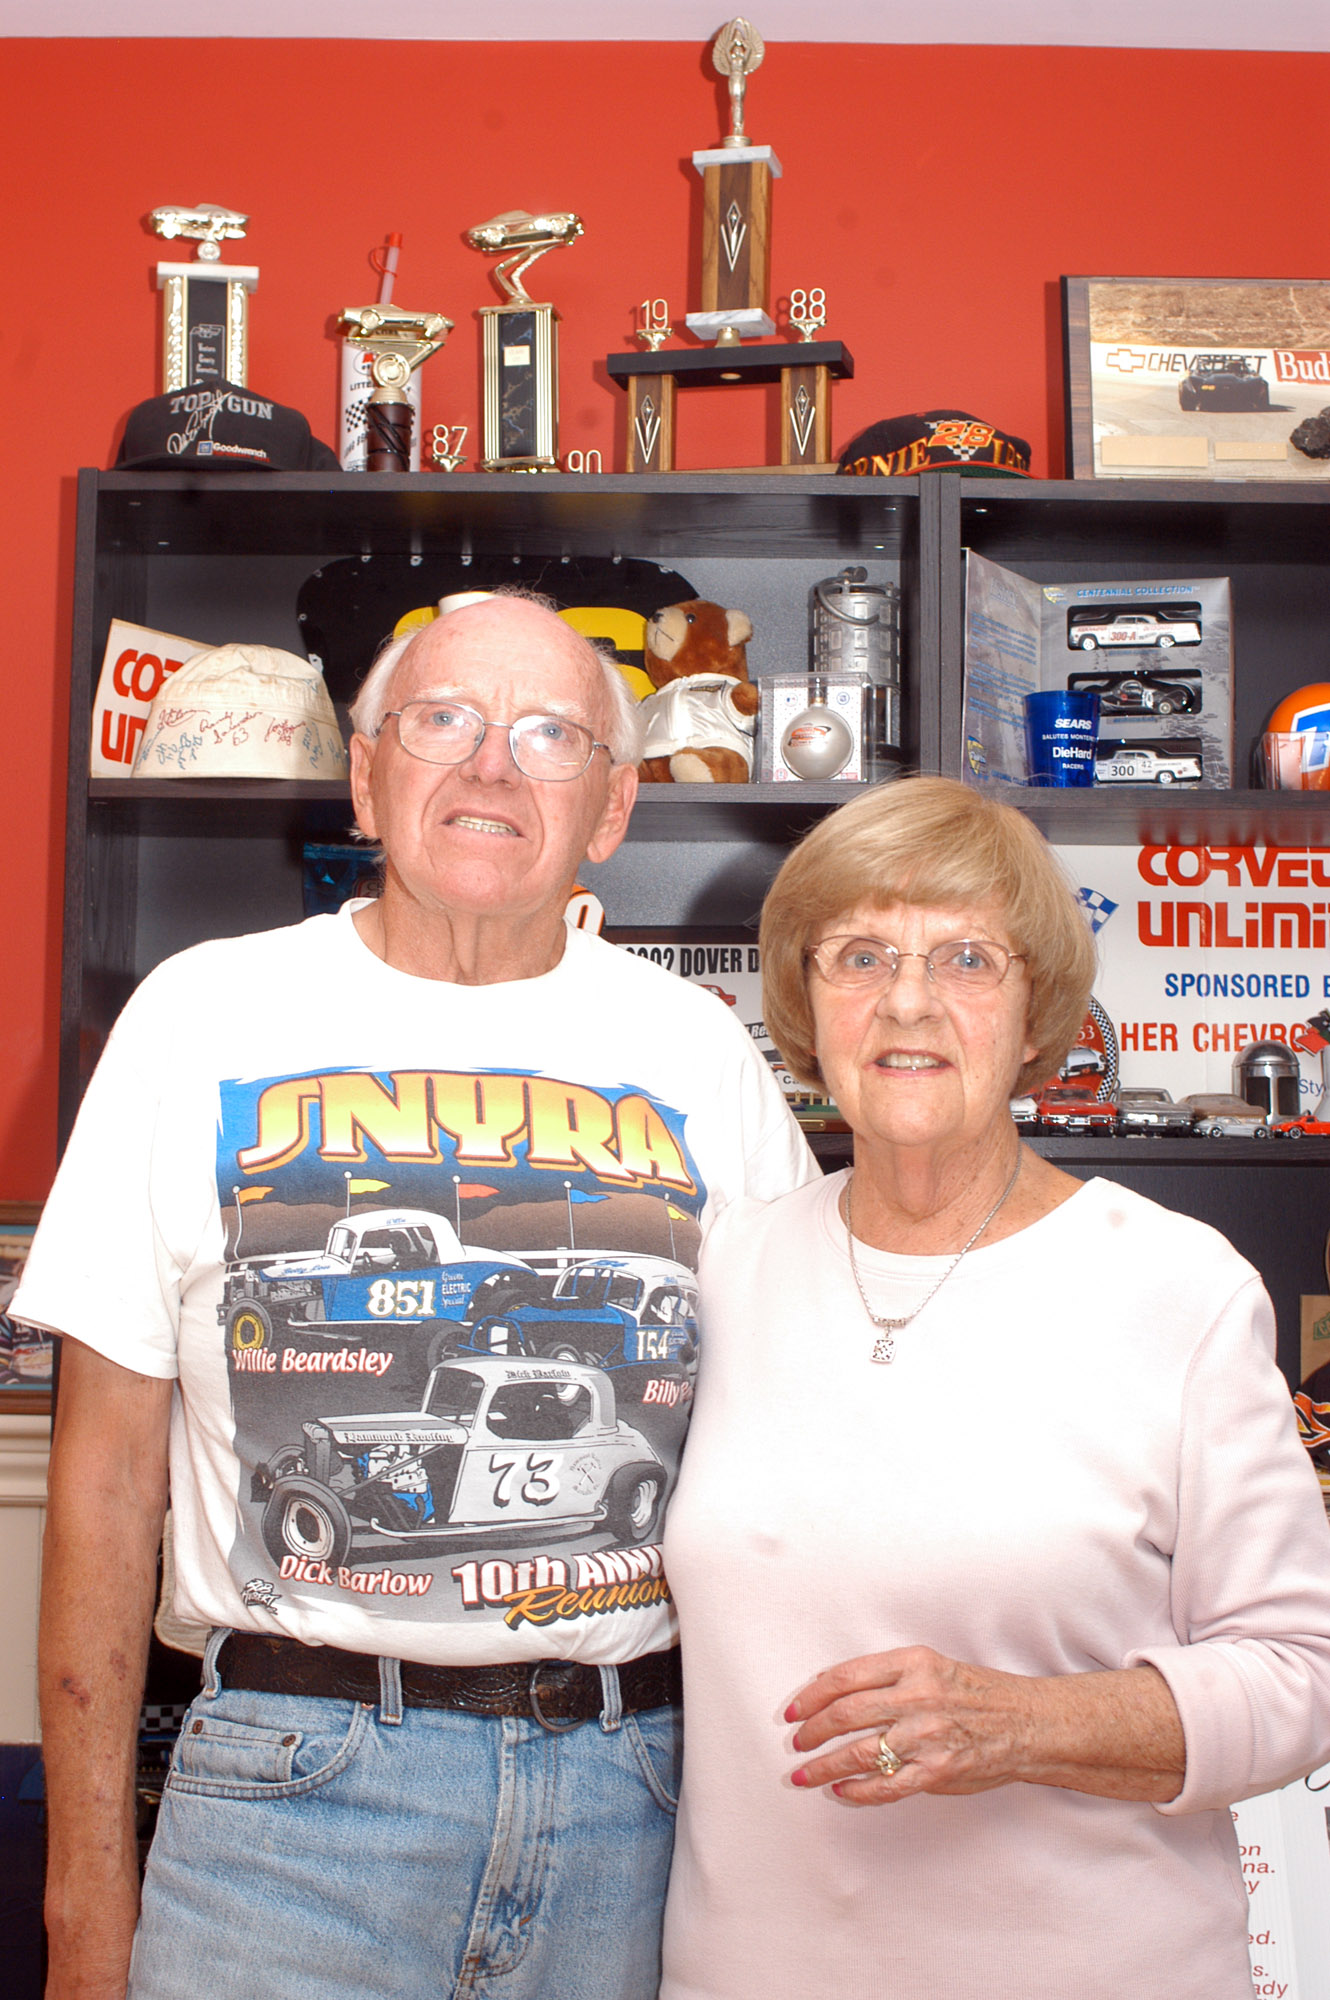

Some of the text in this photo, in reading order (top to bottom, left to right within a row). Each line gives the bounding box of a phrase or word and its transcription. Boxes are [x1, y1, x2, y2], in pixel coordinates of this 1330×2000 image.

[641, 288, 826, 330] 19 88
[170, 391, 274, 420] TOP GUN
[432, 424, 468, 457] 87
[928, 423, 995, 448] 28
[1076, 588, 1132, 599] CENTENNIAL
[1134, 585, 1193, 597] COLLECTION
[1042, 733, 1069, 741] SALUTES
[1054, 718, 1093, 730] SEARS
[1052, 746, 1093, 760] DieHard
[1062, 762, 1085, 770] RACERS
[1111, 765, 1135, 777] 300
[679, 947, 743, 978] DOVER
[1165, 972, 1311, 998] SPONSORED
[1121, 1021, 1179, 1052] HER
[366, 1278, 437, 1318] 851
[441, 1282, 472, 1295] ELECTRIC
[232, 1346, 395, 1378] Willie Beardsley
[641, 1378, 681, 1408] Billy
[488, 1452, 564, 1509] 73
[279, 1554, 434, 1597] Dick Barlow
[452, 1543, 664, 1611] 10th ANNI
[502, 1570, 673, 1631] Reunion
